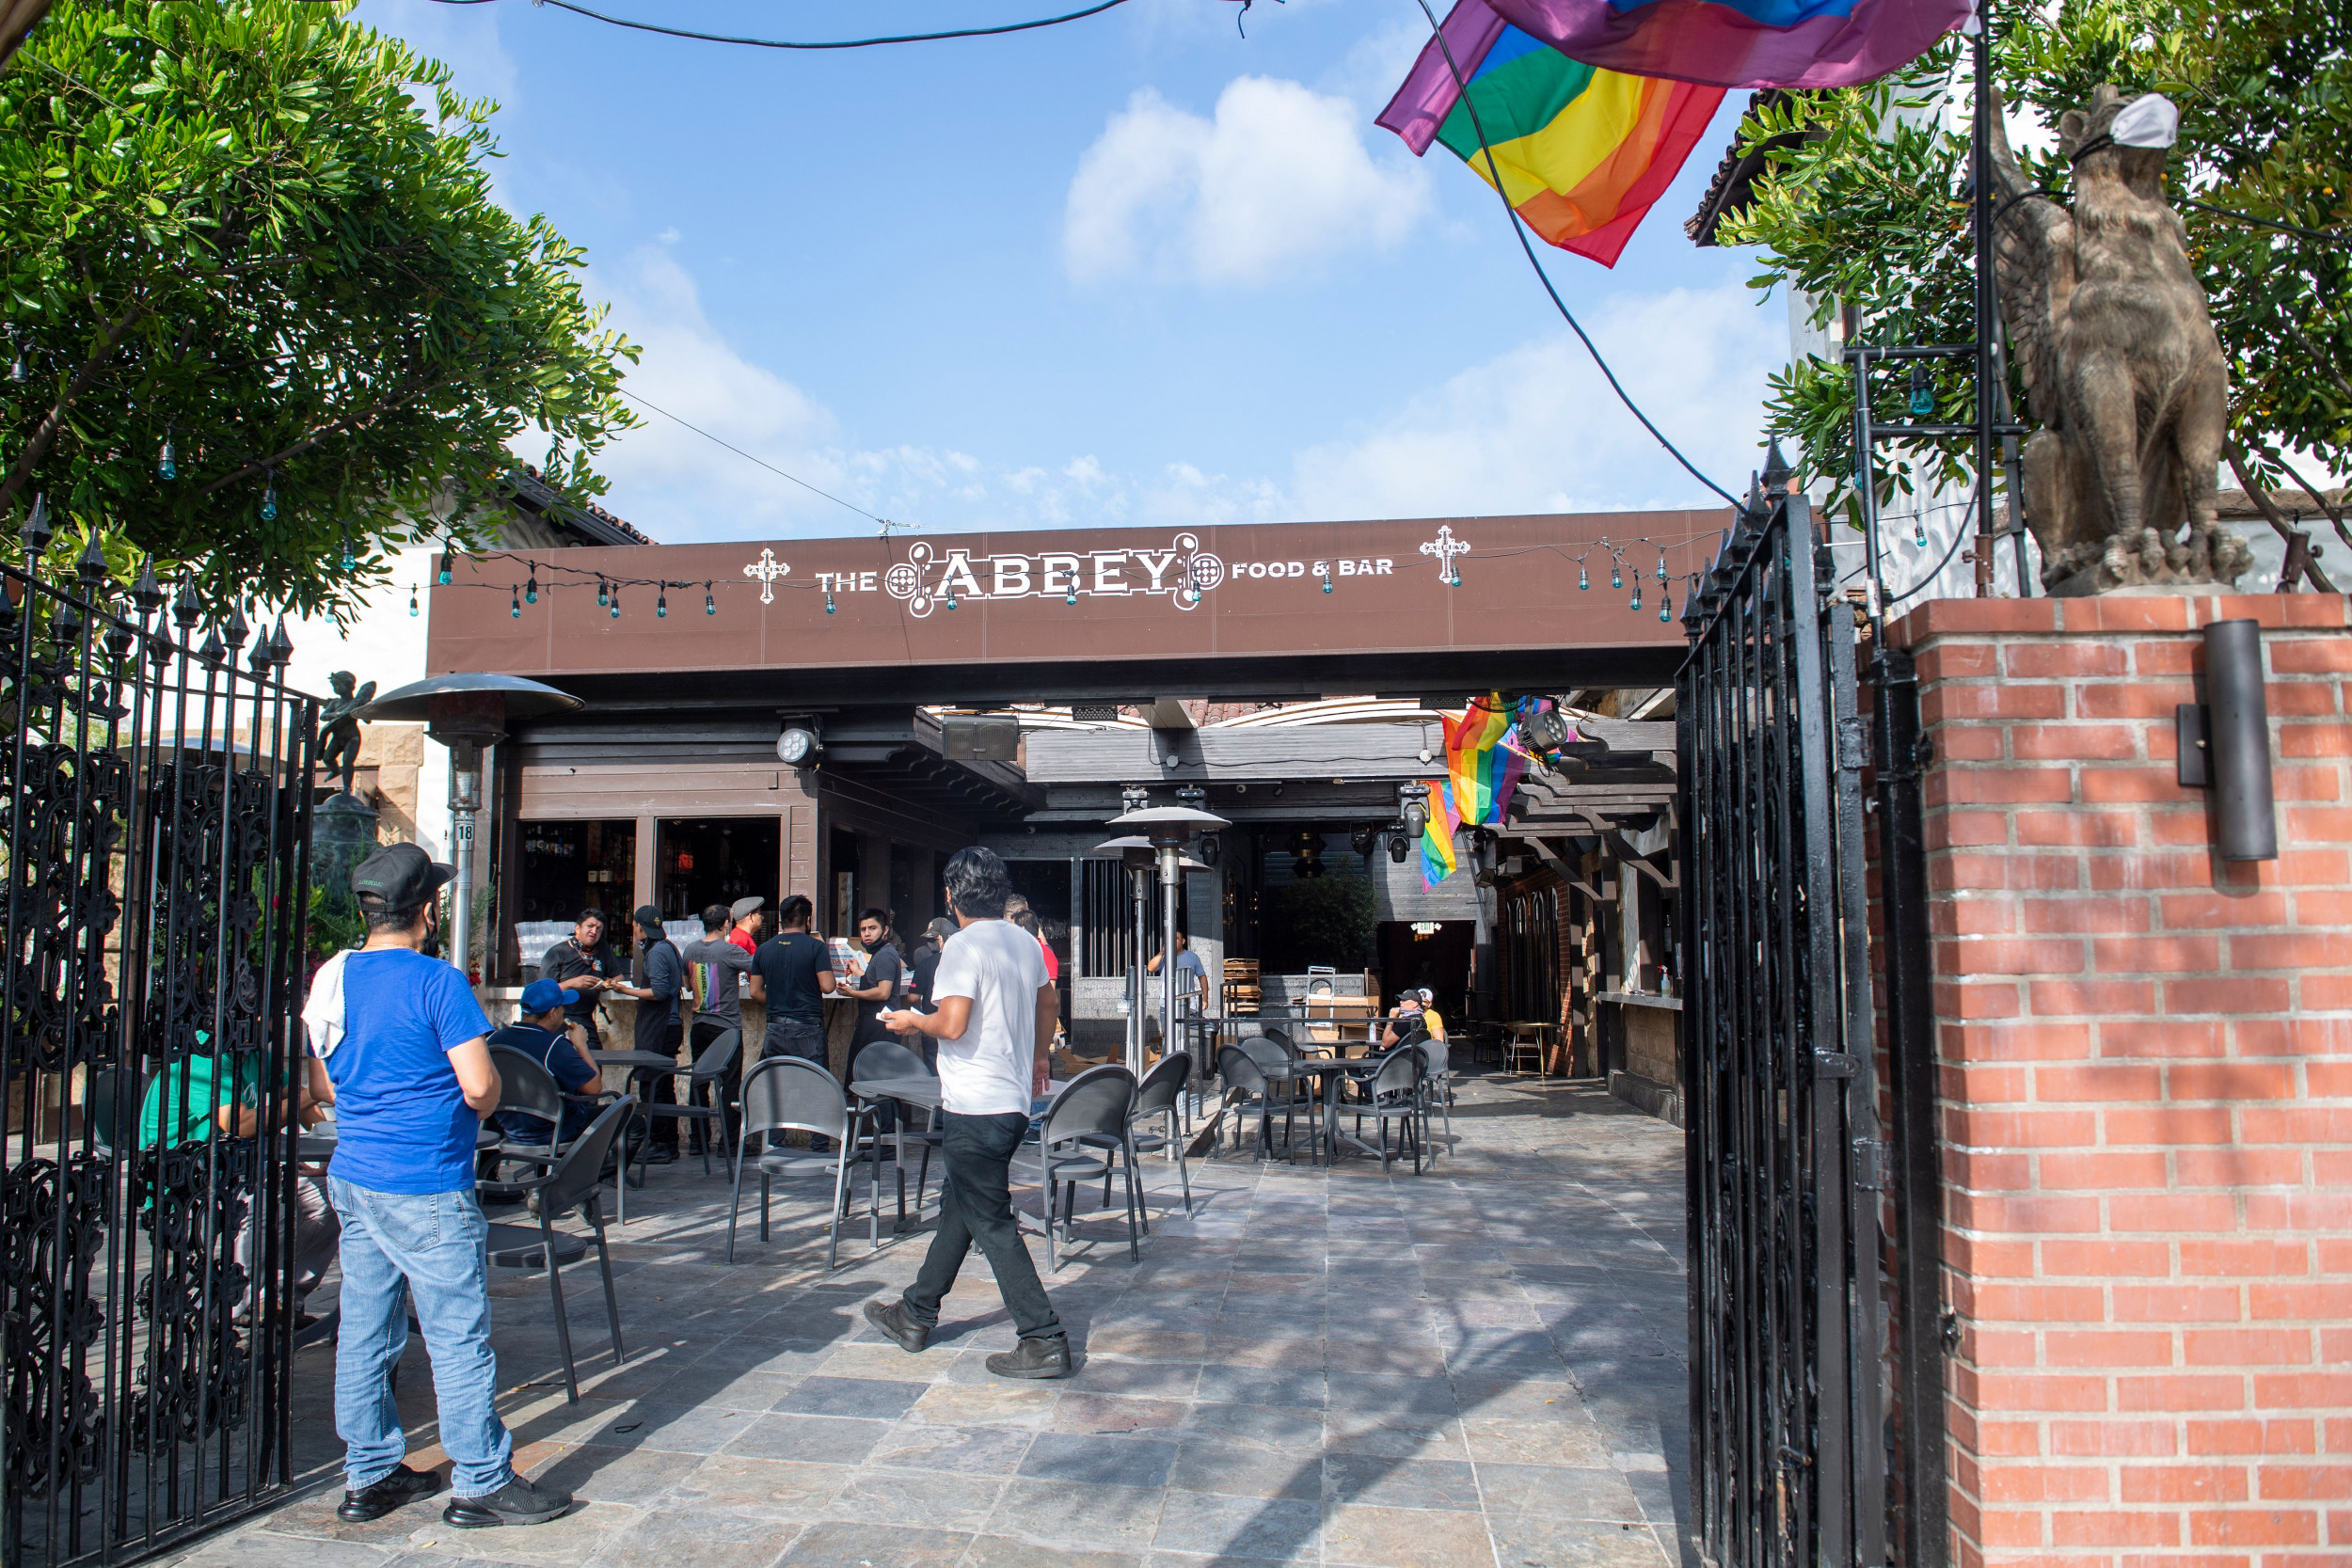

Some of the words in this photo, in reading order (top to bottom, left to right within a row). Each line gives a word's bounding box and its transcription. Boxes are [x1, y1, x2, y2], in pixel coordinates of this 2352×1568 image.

[1428, 544, 1463, 552] ABBEY
[815, 571, 878, 593] THE
[933, 551, 1177, 598] ABBEY
[1232, 561, 1305, 579] FOOD
[1311, 561, 1330, 577] &
[1339, 559, 1393, 577] BAR
[458, 825, 473, 840] 18
